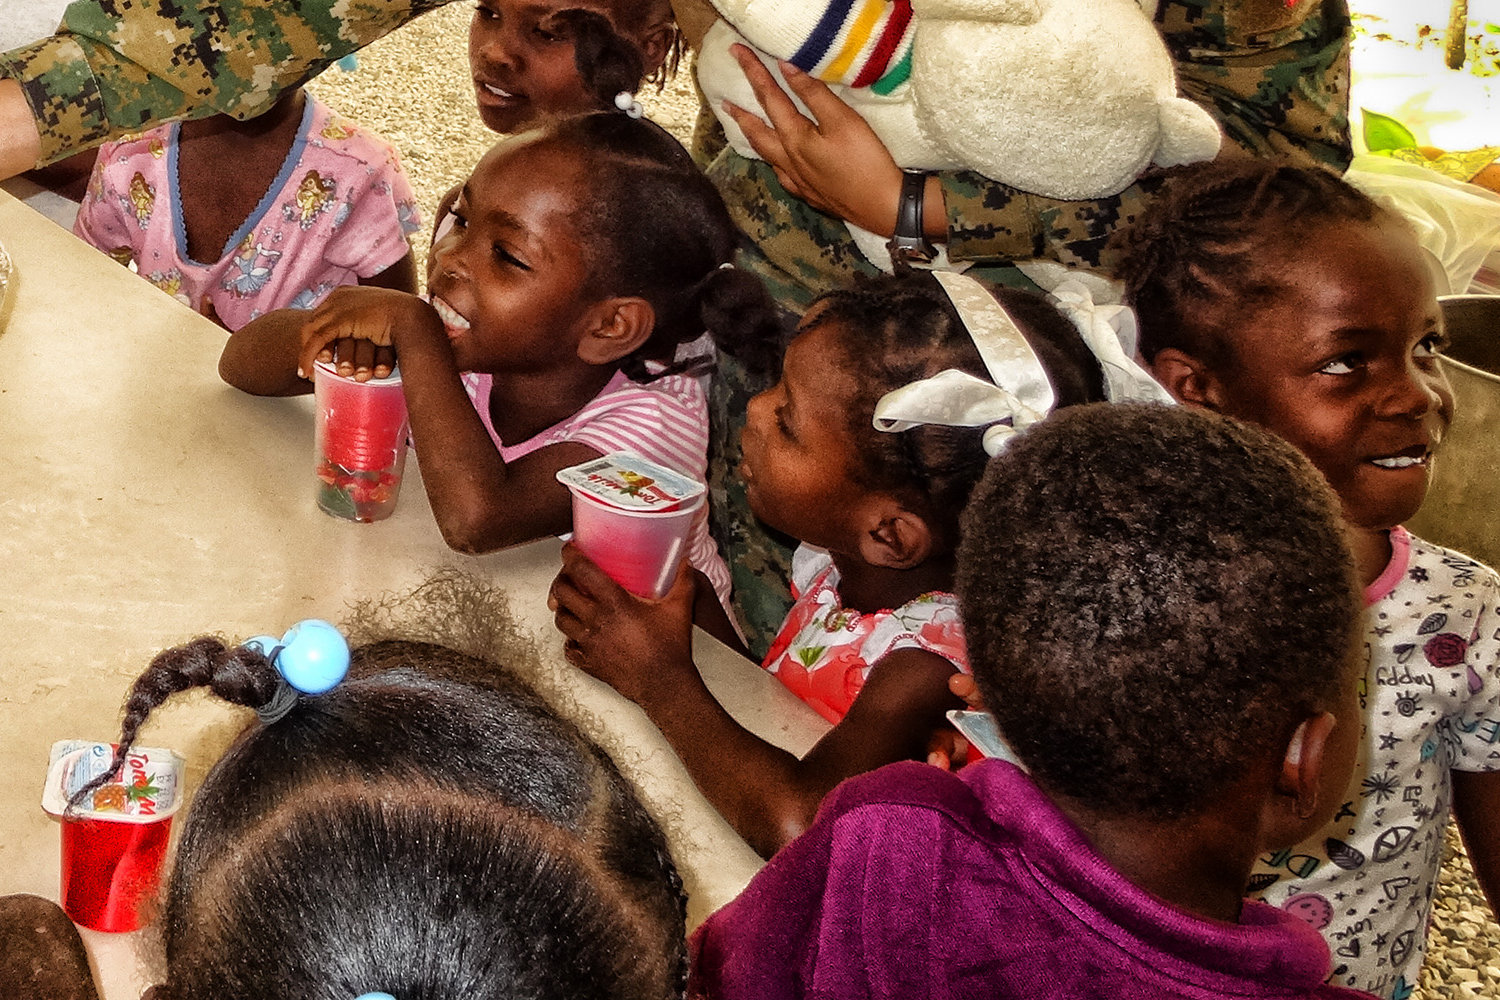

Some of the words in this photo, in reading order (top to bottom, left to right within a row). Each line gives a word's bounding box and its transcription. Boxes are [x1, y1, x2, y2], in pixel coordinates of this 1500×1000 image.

[587, 473, 622, 489] Milk
[1376, 666, 1436, 694] happy
[126, 753, 149, 790] Tom
